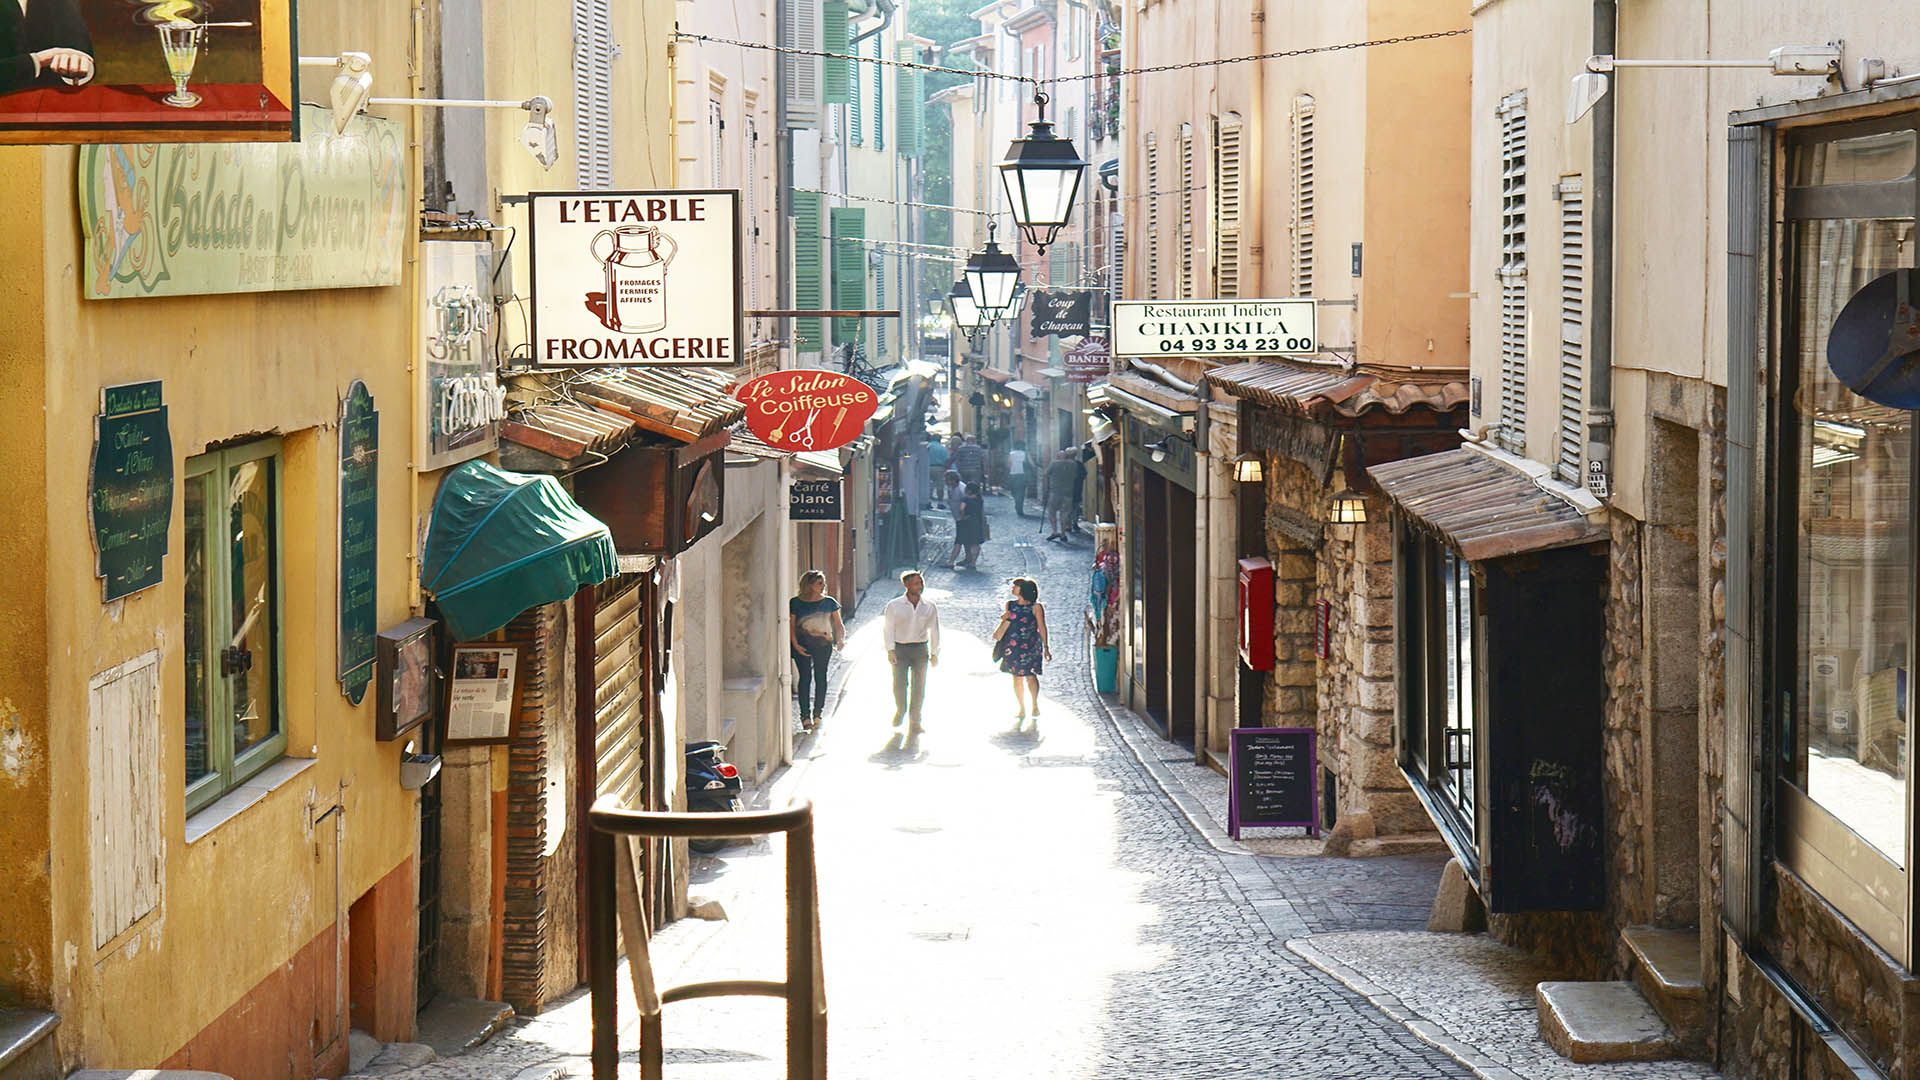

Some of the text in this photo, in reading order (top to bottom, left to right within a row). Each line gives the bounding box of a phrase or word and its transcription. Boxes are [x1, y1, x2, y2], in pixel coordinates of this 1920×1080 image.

[162, 147, 254, 258] Balade
[559, 198, 706, 224] L'ETABLE
[619, 279, 662, 287] FROMAGES
[619, 296, 653, 304] AFFINES
[1048, 297, 1076, 309] Coup
[1055, 309, 1069, 319] de
[1143, 304, 1282, 318] Restaurant Indien
[1040, 320, 1084, 332] Chapeau
[1138, 321, 1289, 336] CHAMKILA
[546, 336, 730, 360] FROMAGERIE
[1160, 337, 1312, 352] 04 93 34 23 00
[742, 372, 850, 403] Le Salon
[759, 390, 870, 416] Coiffeuse
[789, 494, 834, 505] blanc
